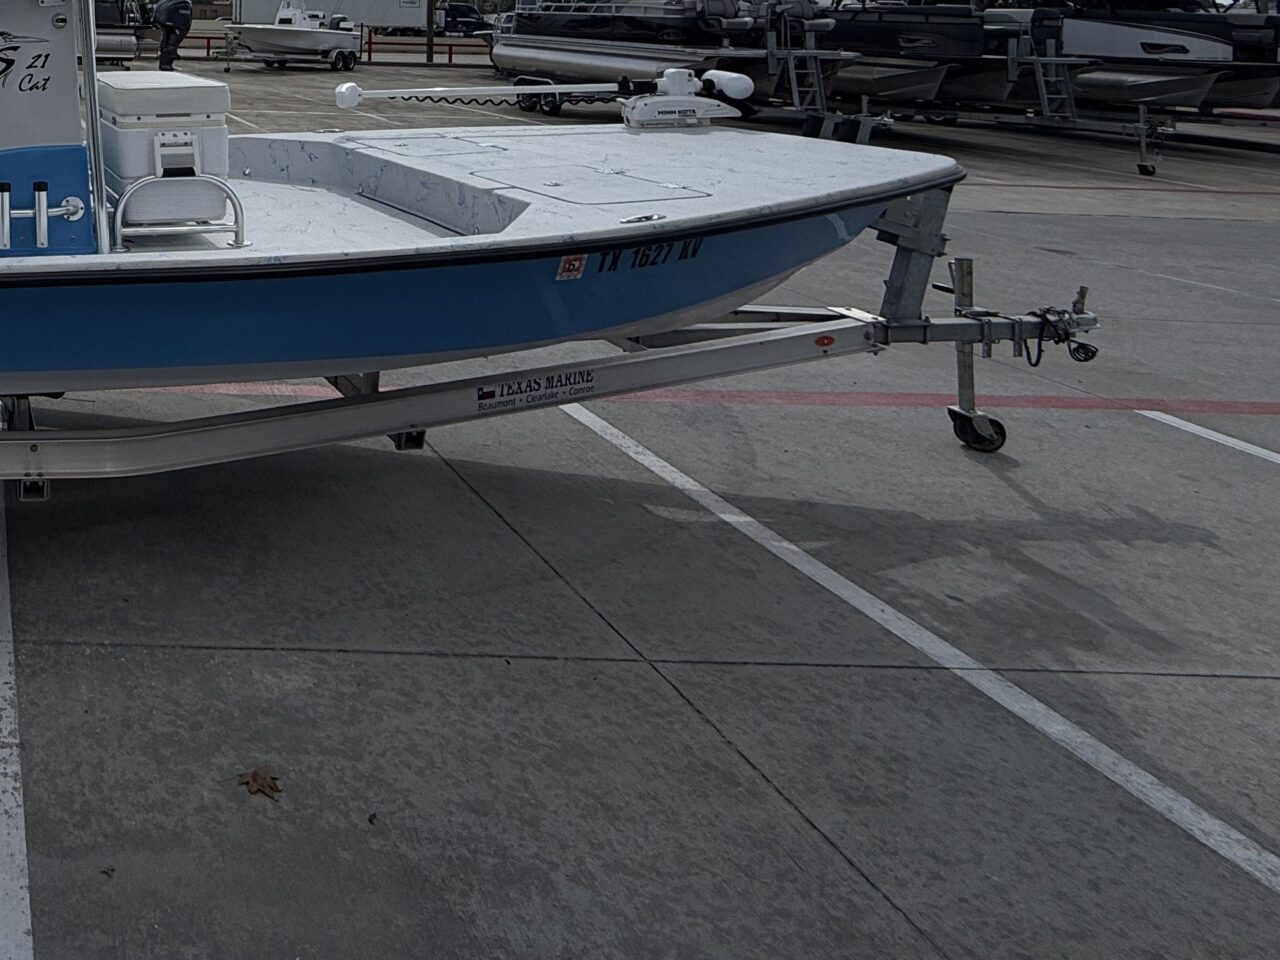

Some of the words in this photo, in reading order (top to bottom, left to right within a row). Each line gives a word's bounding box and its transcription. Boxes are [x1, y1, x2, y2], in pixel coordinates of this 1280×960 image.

[25, 53, 51, 70] 21
[18, 73, 51, 92] Cat
[597, 248, 623, 273] TX
[630, 243, 674, 269] 1627
[499, 378, 541, 398] TEXAS
[545, 369, 594, 390] MARINE
[477, 398, 516, 412] Beaumont
[526, 390, 560, 404] Clearlake
[568, 385, 595, 397] Conroe
